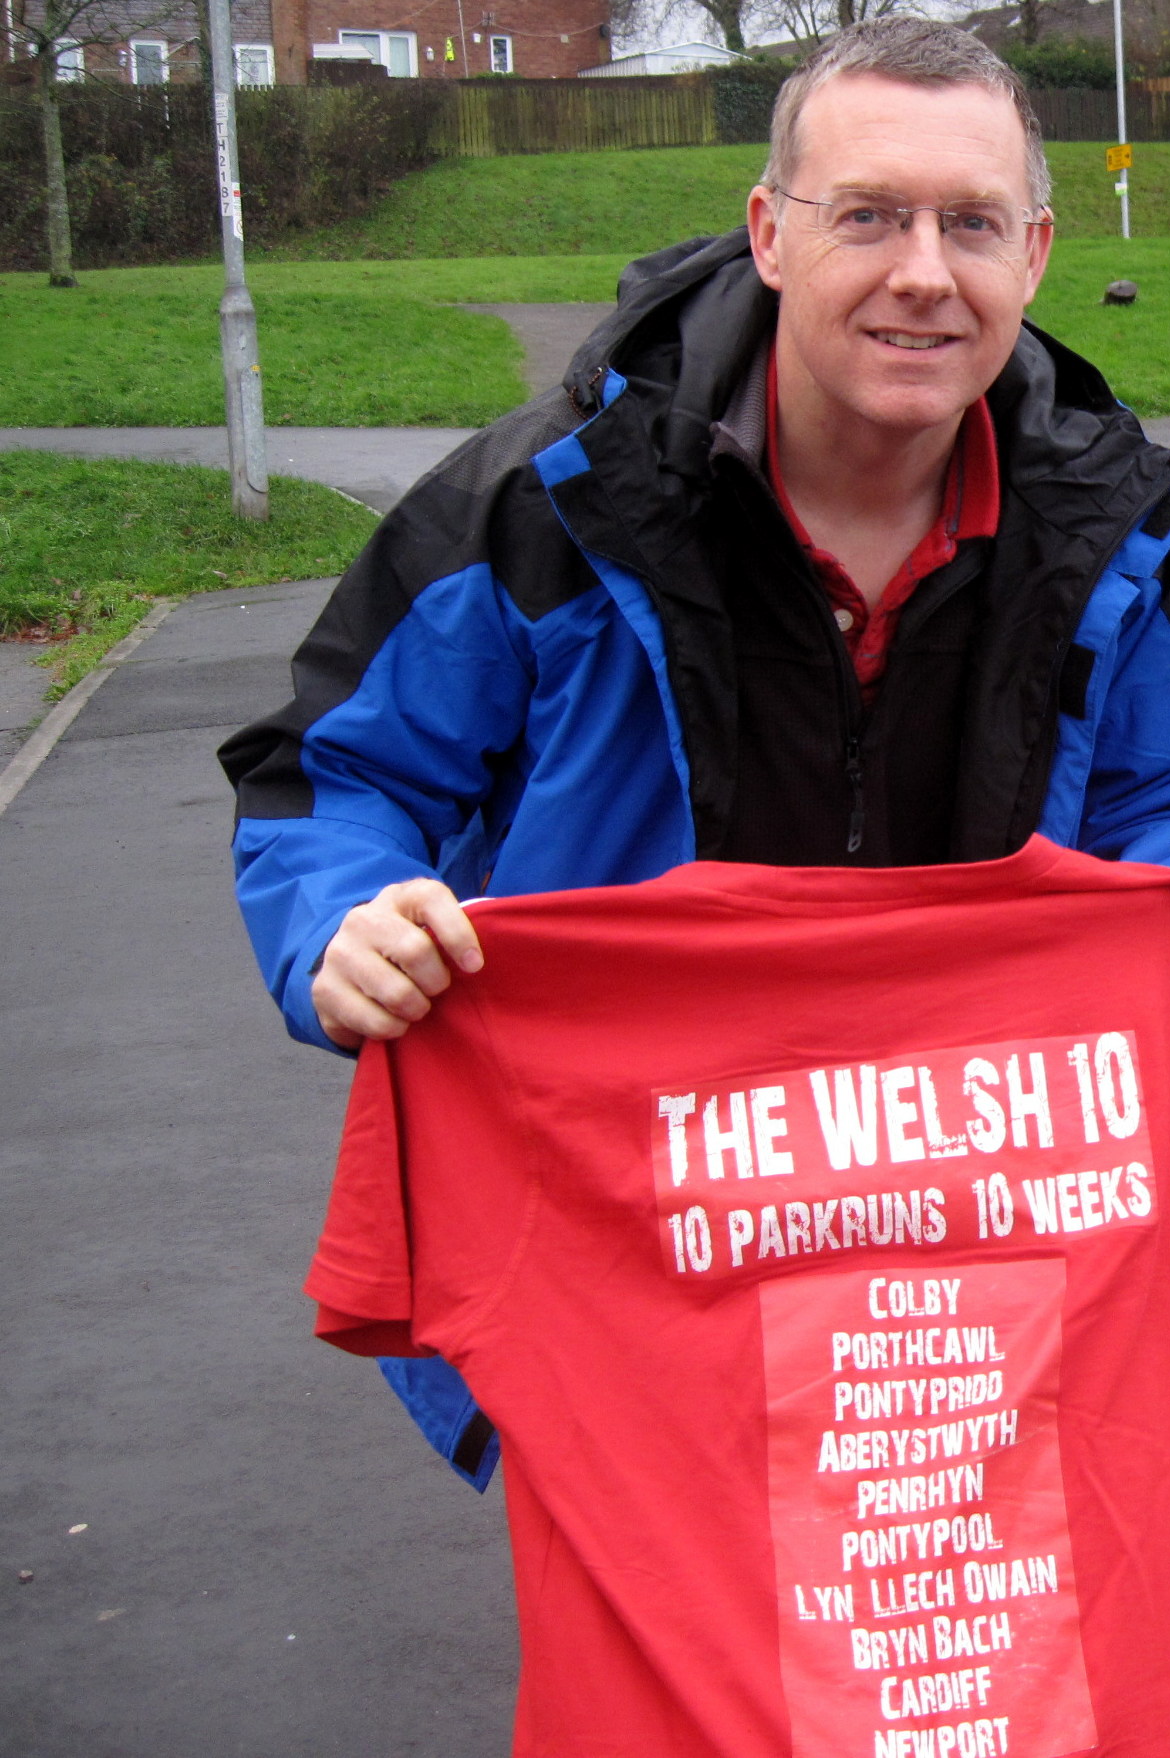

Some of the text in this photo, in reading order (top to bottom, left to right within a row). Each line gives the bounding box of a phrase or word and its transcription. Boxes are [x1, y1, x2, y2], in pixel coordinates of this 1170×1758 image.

[658, 1031, 1141, 1187] THE WELSH 10
[667, 1160, 1152, 1273] 10 PARKRUNS 10 WEEKS
[868, 1277, 961, 1320] COLBY
[831, 1326, 1005, 1372] PORTHCAWL
[834, 1370, 1003, 1422] PONTYPRIDD
[817, 1409, 1018, 1474] ABERYSTWYTH
[856, 1462, 983, 1520] PENRHYN
[841, 1512, 1003, 1572] PONTYPOOL
[795, 1555, 1058, 1622] LYN LLECH OWAIN
[850, 1612, 1012, 1670] BRYN BACH
[880, 1666, 992, 1720] CARDIFF
[874, 1716, 1009, 1758] NEWPORT
